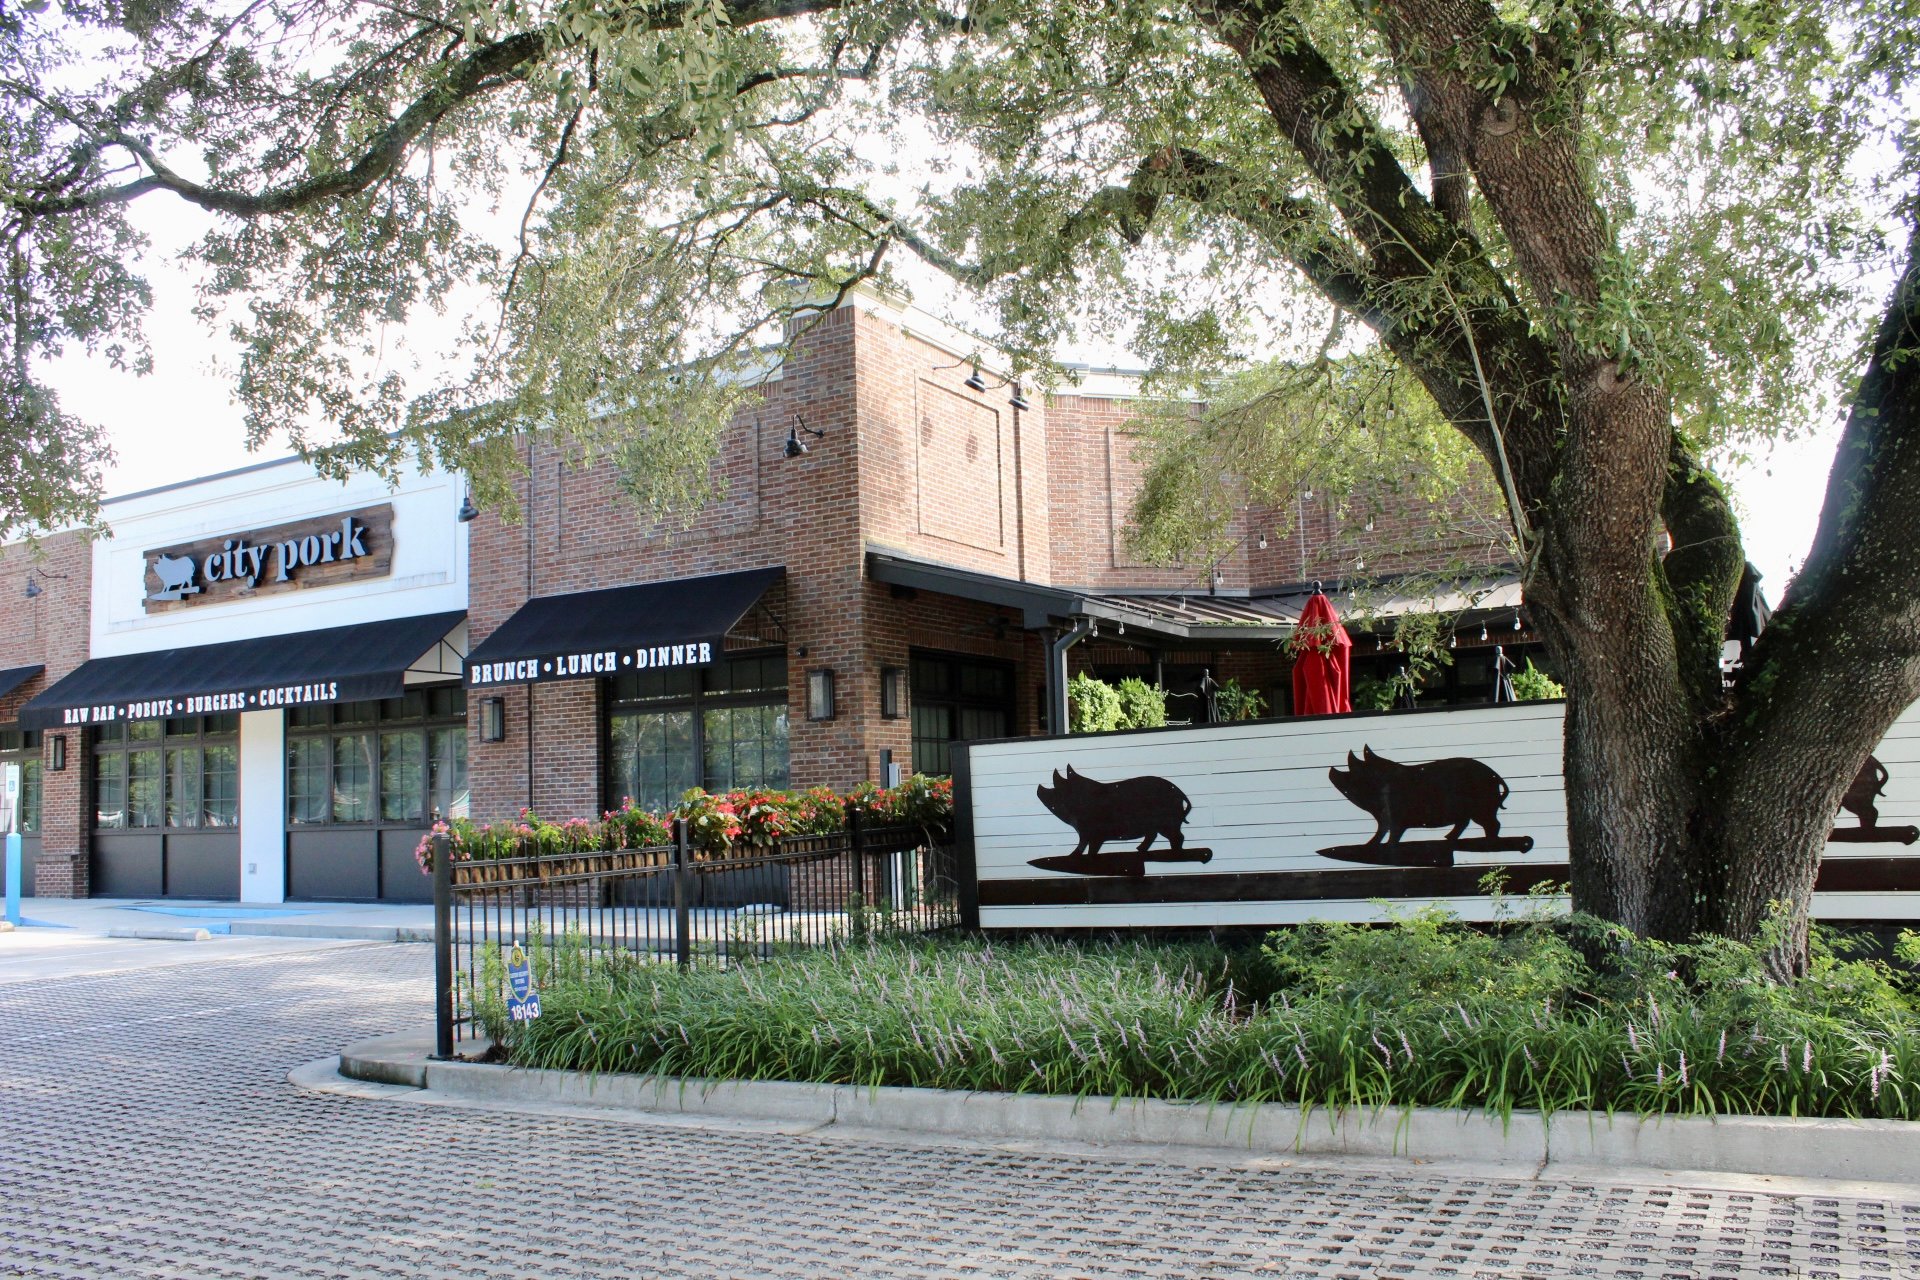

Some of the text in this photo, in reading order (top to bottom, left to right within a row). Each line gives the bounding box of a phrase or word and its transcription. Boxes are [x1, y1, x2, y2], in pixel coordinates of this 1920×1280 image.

[203, 516, 367, 589] city pork
[471, 642, 711, 684] BRUNCH LUNCH DINNER
[64, 682, 337, 724] RAW BAR POBOYS BURGERS COCKTAILS
[511, 1002, 539, 1020] 18143
